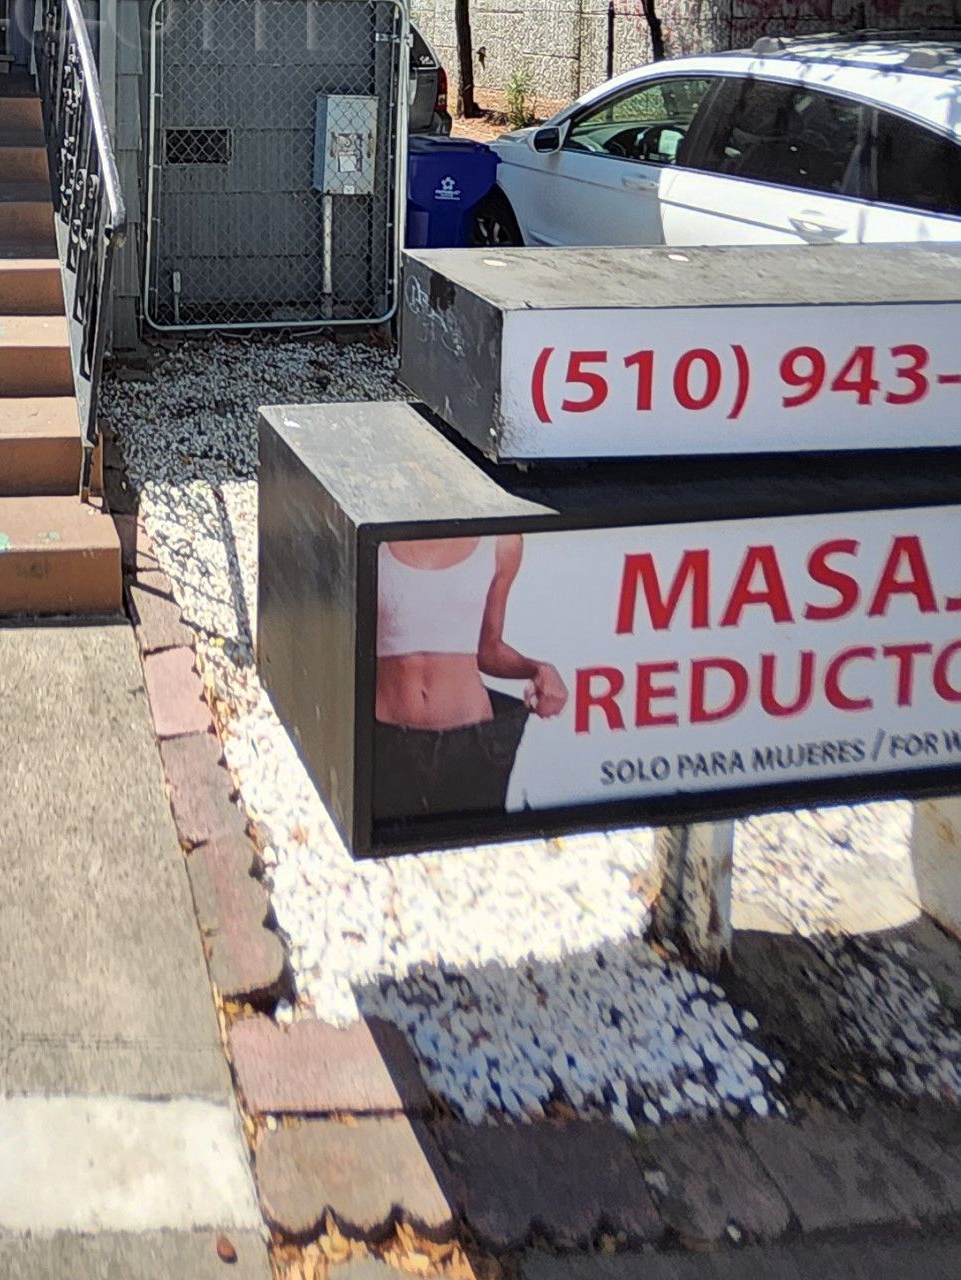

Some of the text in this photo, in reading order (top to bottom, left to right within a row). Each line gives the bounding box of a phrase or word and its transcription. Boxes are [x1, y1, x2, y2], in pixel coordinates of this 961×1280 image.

[531, 344, 961, 424] (510) 943-
[615, 534, 961, 635] MASA
[600, 755, 672, 786] SOLO
[677, 749, 746, 779] PARA
[752, 738, 866, 772] MUJERES
[889, 731, 939, 759] FOR
